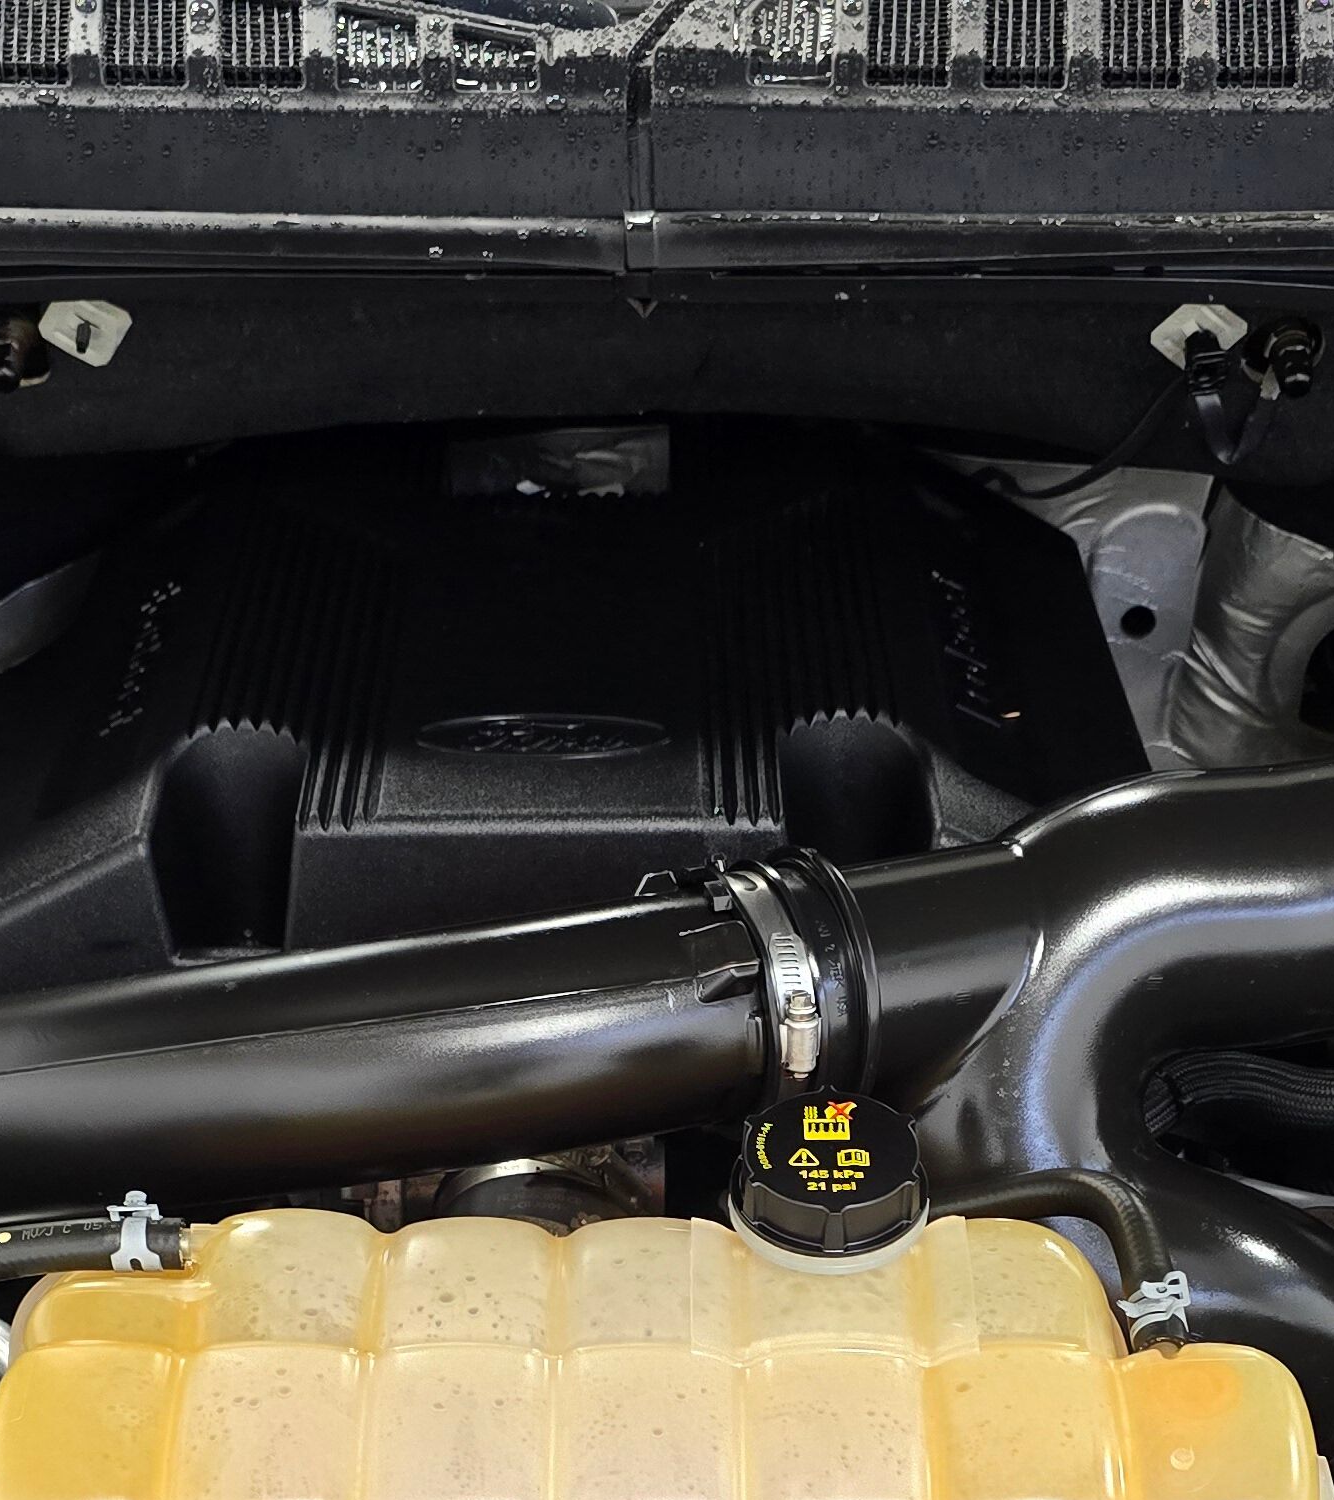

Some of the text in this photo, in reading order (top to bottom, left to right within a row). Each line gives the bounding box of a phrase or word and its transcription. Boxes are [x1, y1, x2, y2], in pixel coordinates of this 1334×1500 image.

[798, 1169, 865, 1179] 145 kPa
[806, 1181, 857, 1193] 21 psi
